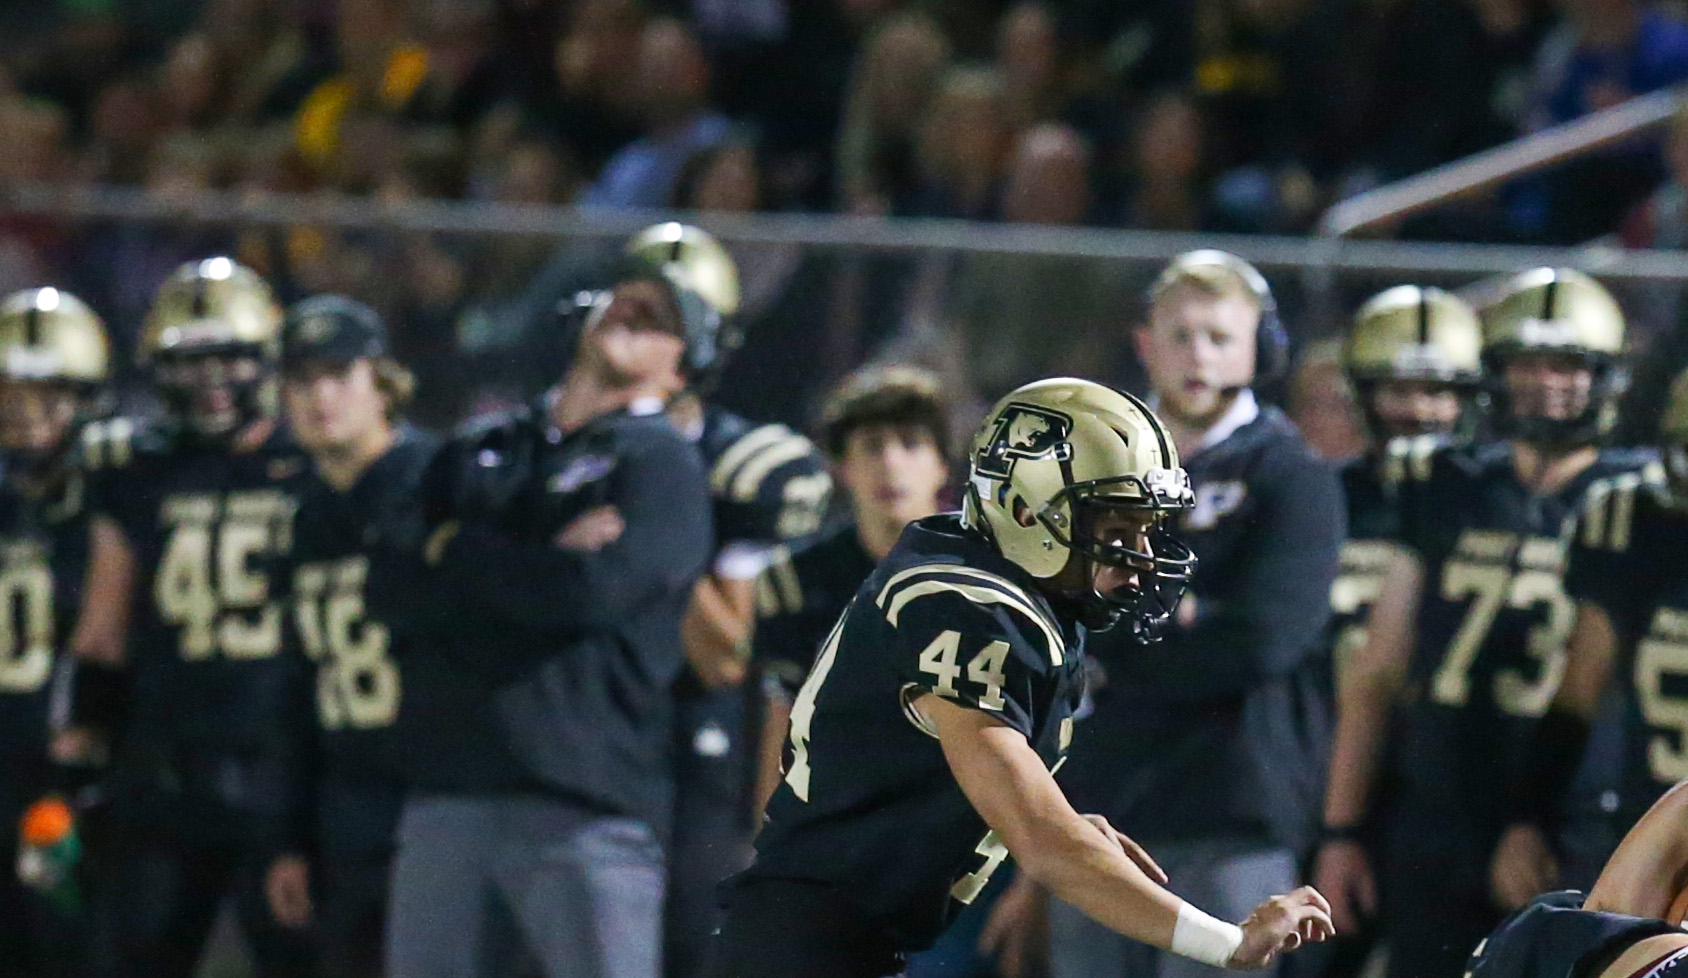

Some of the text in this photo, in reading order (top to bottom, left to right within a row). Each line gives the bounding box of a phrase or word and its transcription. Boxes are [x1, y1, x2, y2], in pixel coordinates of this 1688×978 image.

[154, 523, 283, 661] 45
[1433, 561, 1576, 716] 73
[918, 630, 1011, 711] 44
